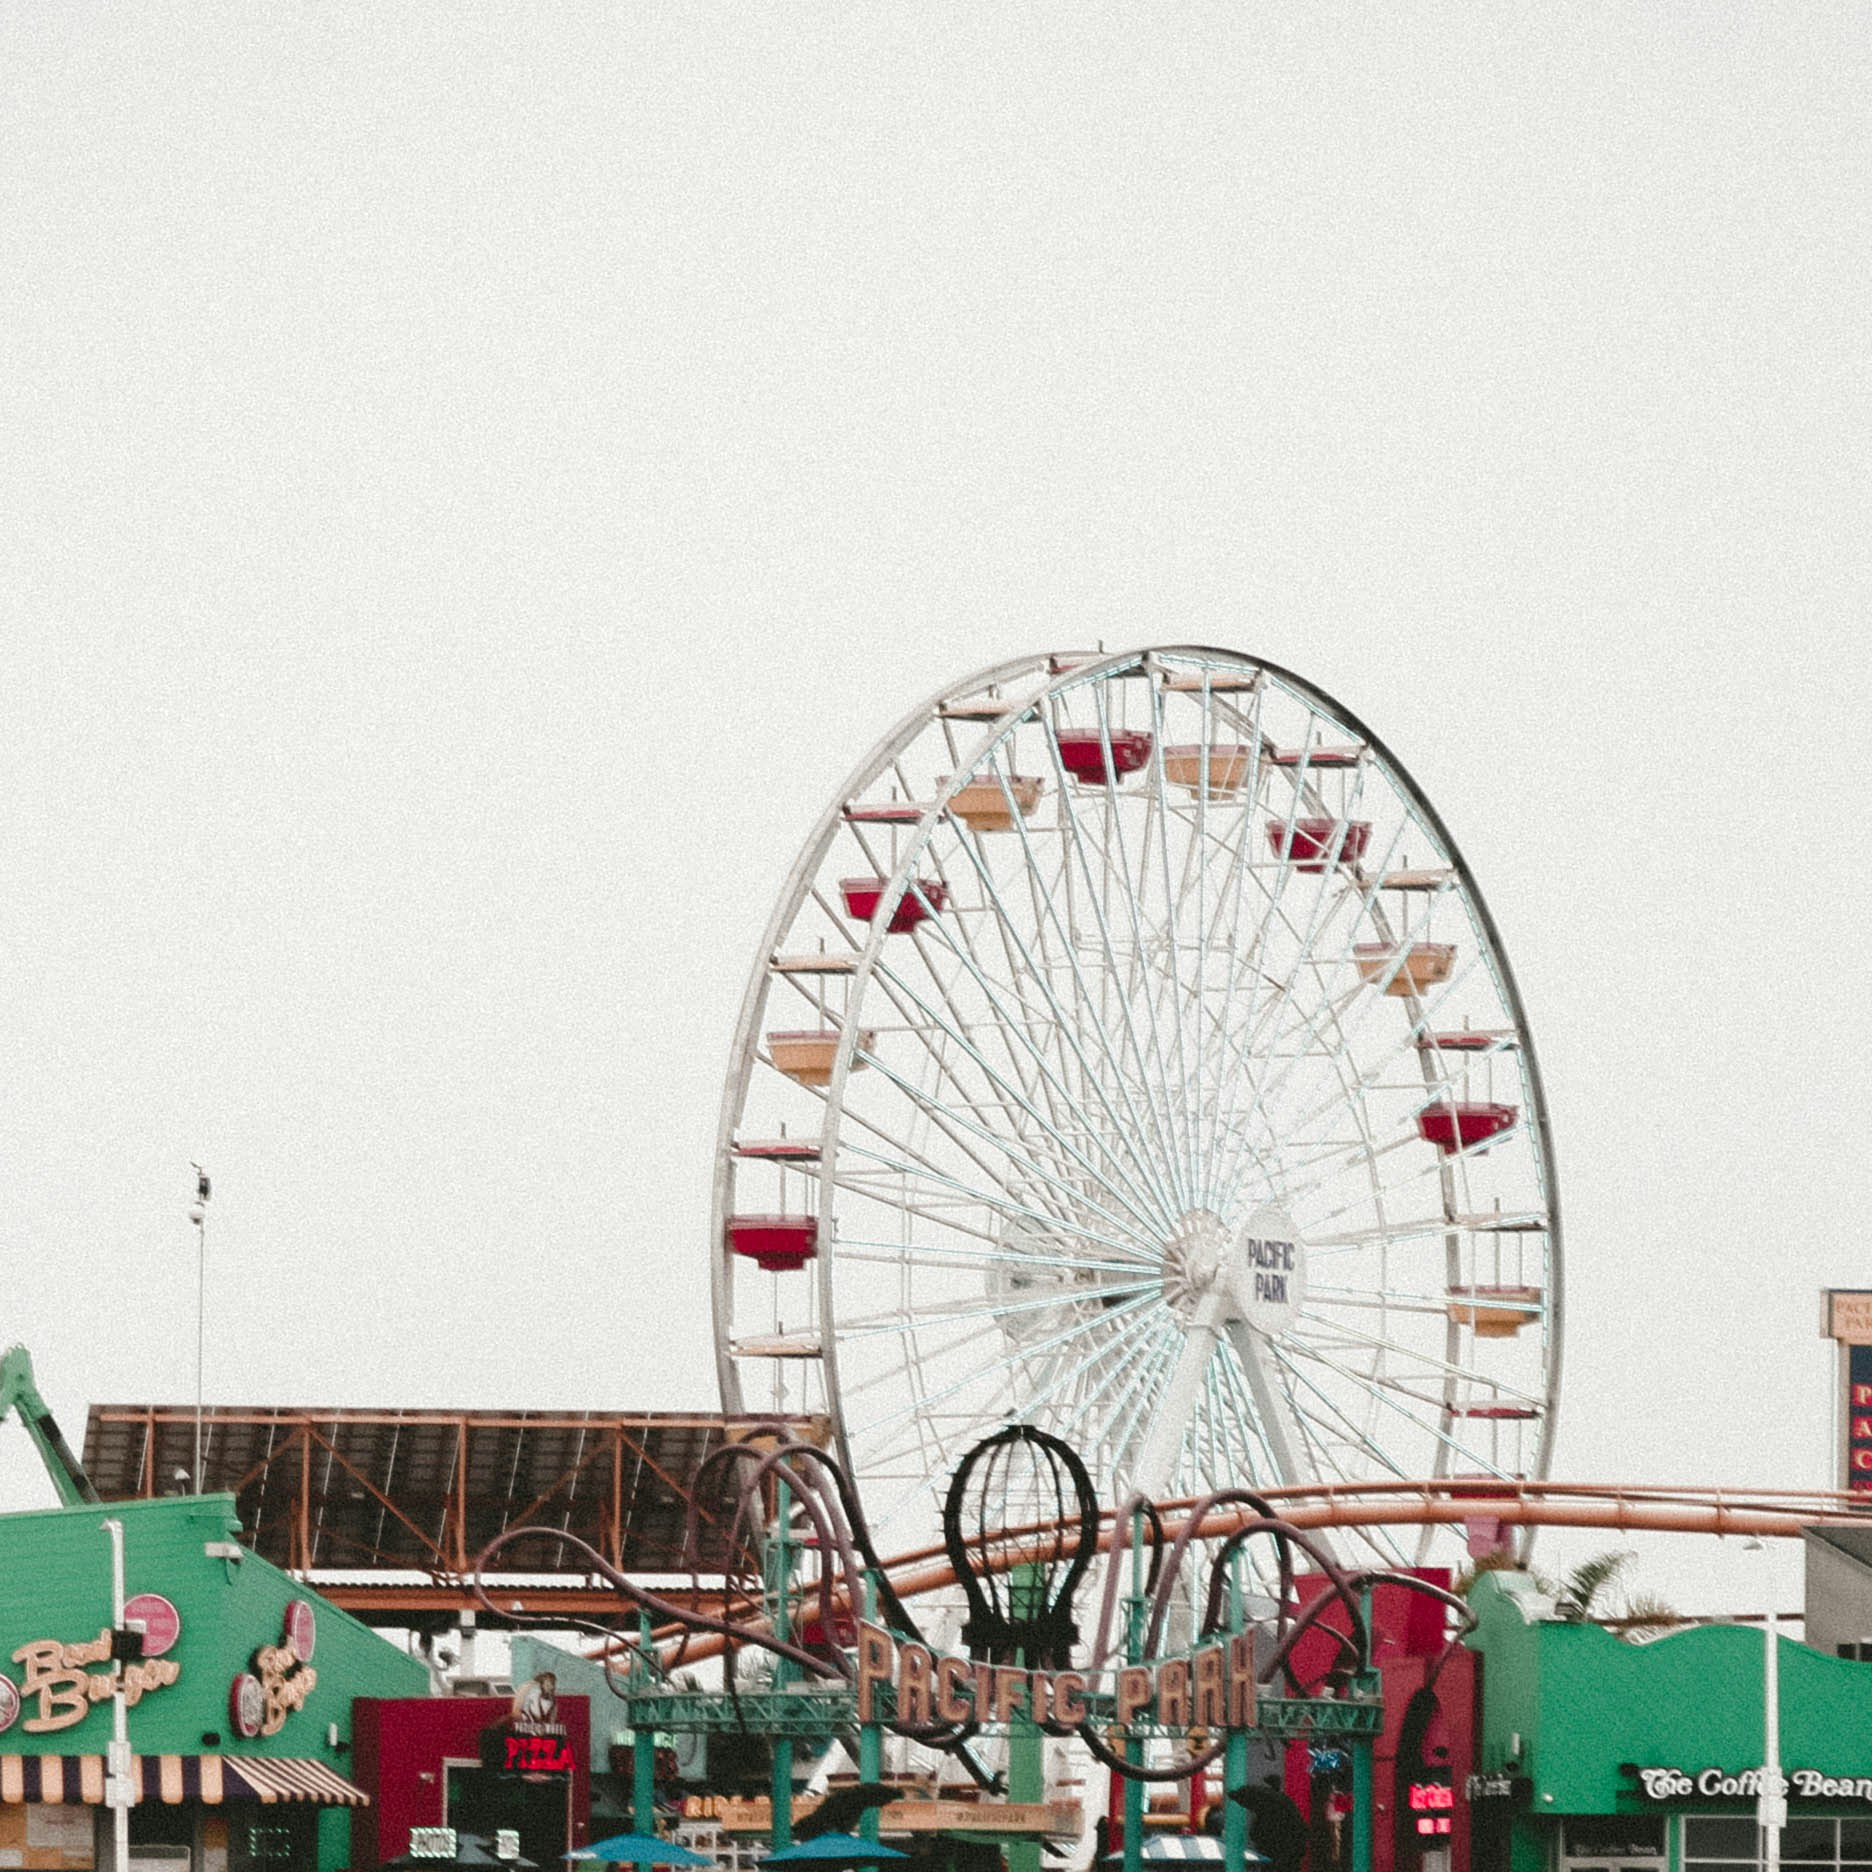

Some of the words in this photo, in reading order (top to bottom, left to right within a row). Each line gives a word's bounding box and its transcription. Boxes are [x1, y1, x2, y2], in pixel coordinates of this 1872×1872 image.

[1247, 1239, 1295, 1271] PACIFIC
[1255, 1272, 1288, 1304] PARK
[857, 1618, 1088, 1725] PACIFIC
[1116, 1628, 1257, 1727] PARK
[504, 1736, 577, 1771] PIZZA
[1640, 1769, 1693, 1799] The
[1697, 1769, 1790, 1796] Coffe
